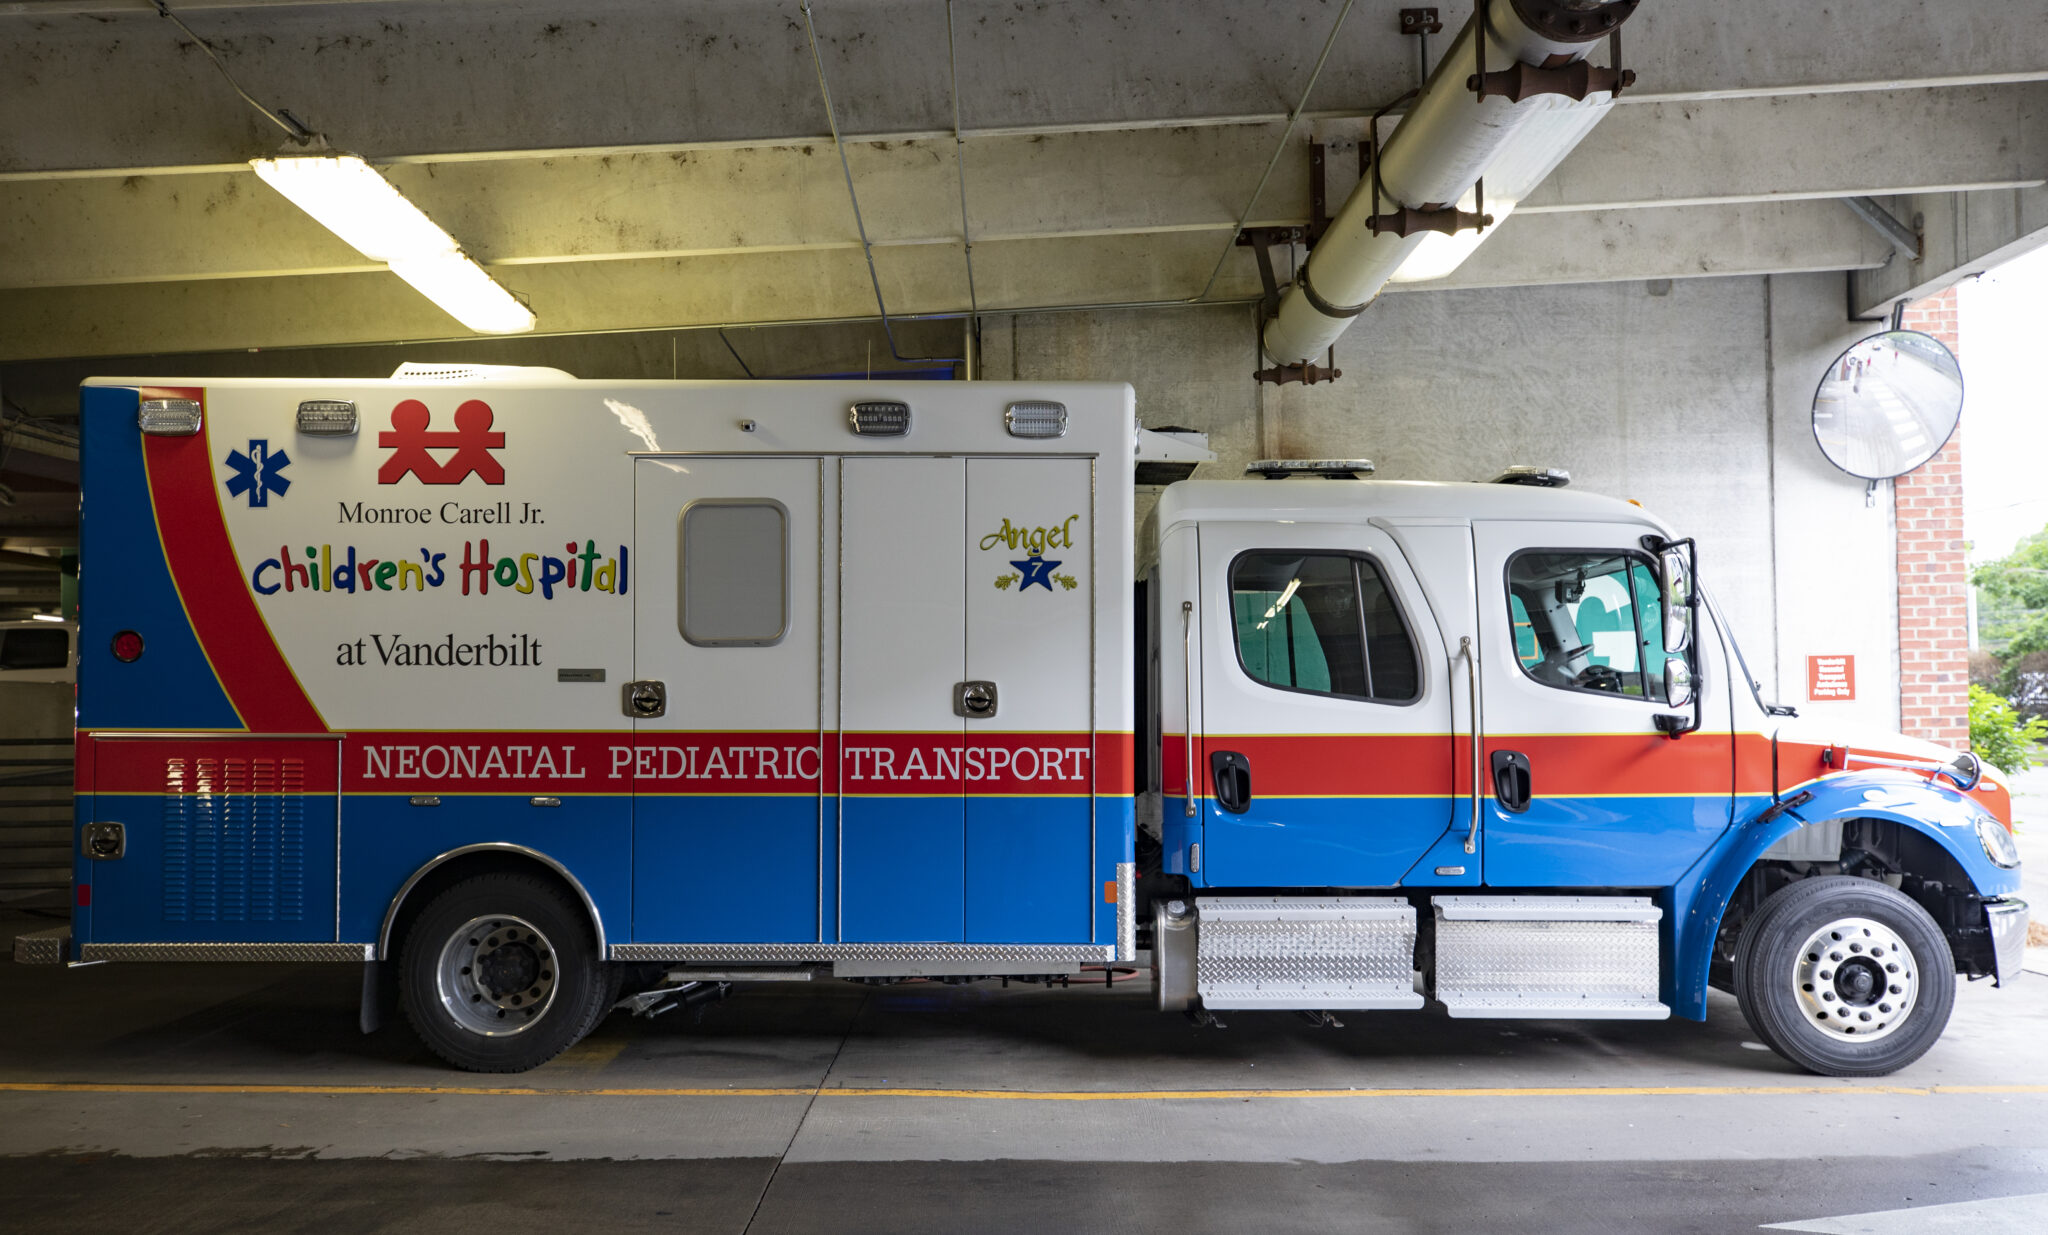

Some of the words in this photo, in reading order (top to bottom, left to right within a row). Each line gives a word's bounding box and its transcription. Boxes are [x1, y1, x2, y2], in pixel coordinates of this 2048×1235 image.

[339, 502, 431, 524] Monroe
[440, 501, 512, 524] Carell
[519, 502, 545, 525] Jr.
[979, 513, 1080, 558] Angel
[252, 543, 446, 596] Children's
[459, 538, 628, 601] Hospital
[1030, 561, 1044, 578] 7
[336, 638, 367, 666] at
[369, 633, 542, 667] Vanderbilt
[362, 745, 586, 779] NEONATAL
[607, 746, 821, 780] PEDIATRIC
[844, 747, 1091, 781] TRANSPORT
